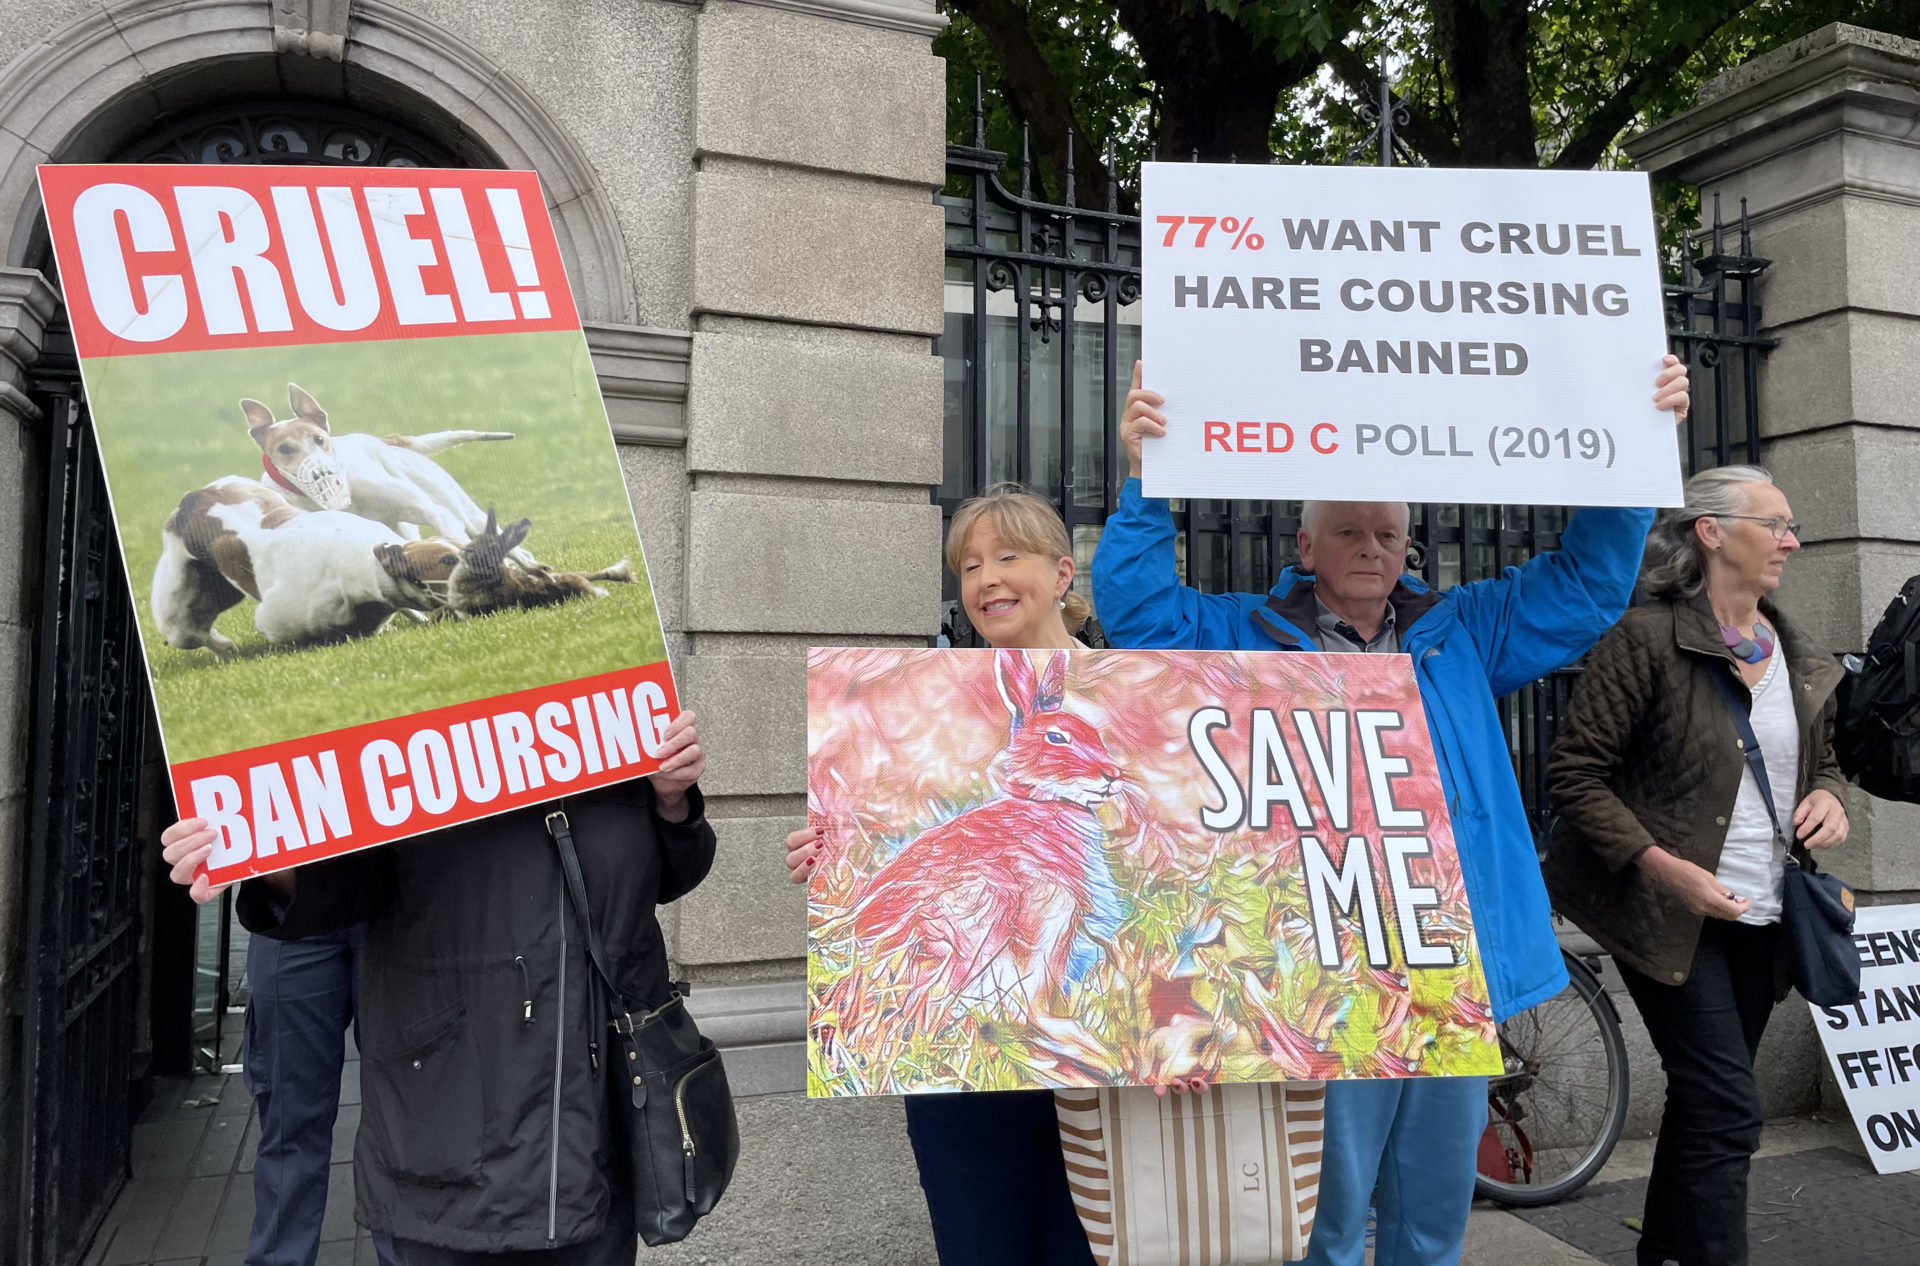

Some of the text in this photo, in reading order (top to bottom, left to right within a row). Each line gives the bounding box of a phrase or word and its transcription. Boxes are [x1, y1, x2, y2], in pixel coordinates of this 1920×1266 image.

[1157, 216, 1641, 257] 77% WANT CRUEL
[73, 183, 552, 342] CRUEL!
[1174, 276, 1630, 317] HARE COURSING
[1300, 339, 1529, 376] BANNED
[1204, 421, 1616, 469] RED C POLL (2019)
[190, 680, 671, 871] BAN COURSING
[1188, 706, 1427, 833] SAVE
[1300, 835, 1458, 969] ME
[1821, 985, 1920, 1031] STAN
[1242, 1162, 1260, 1193] LC
